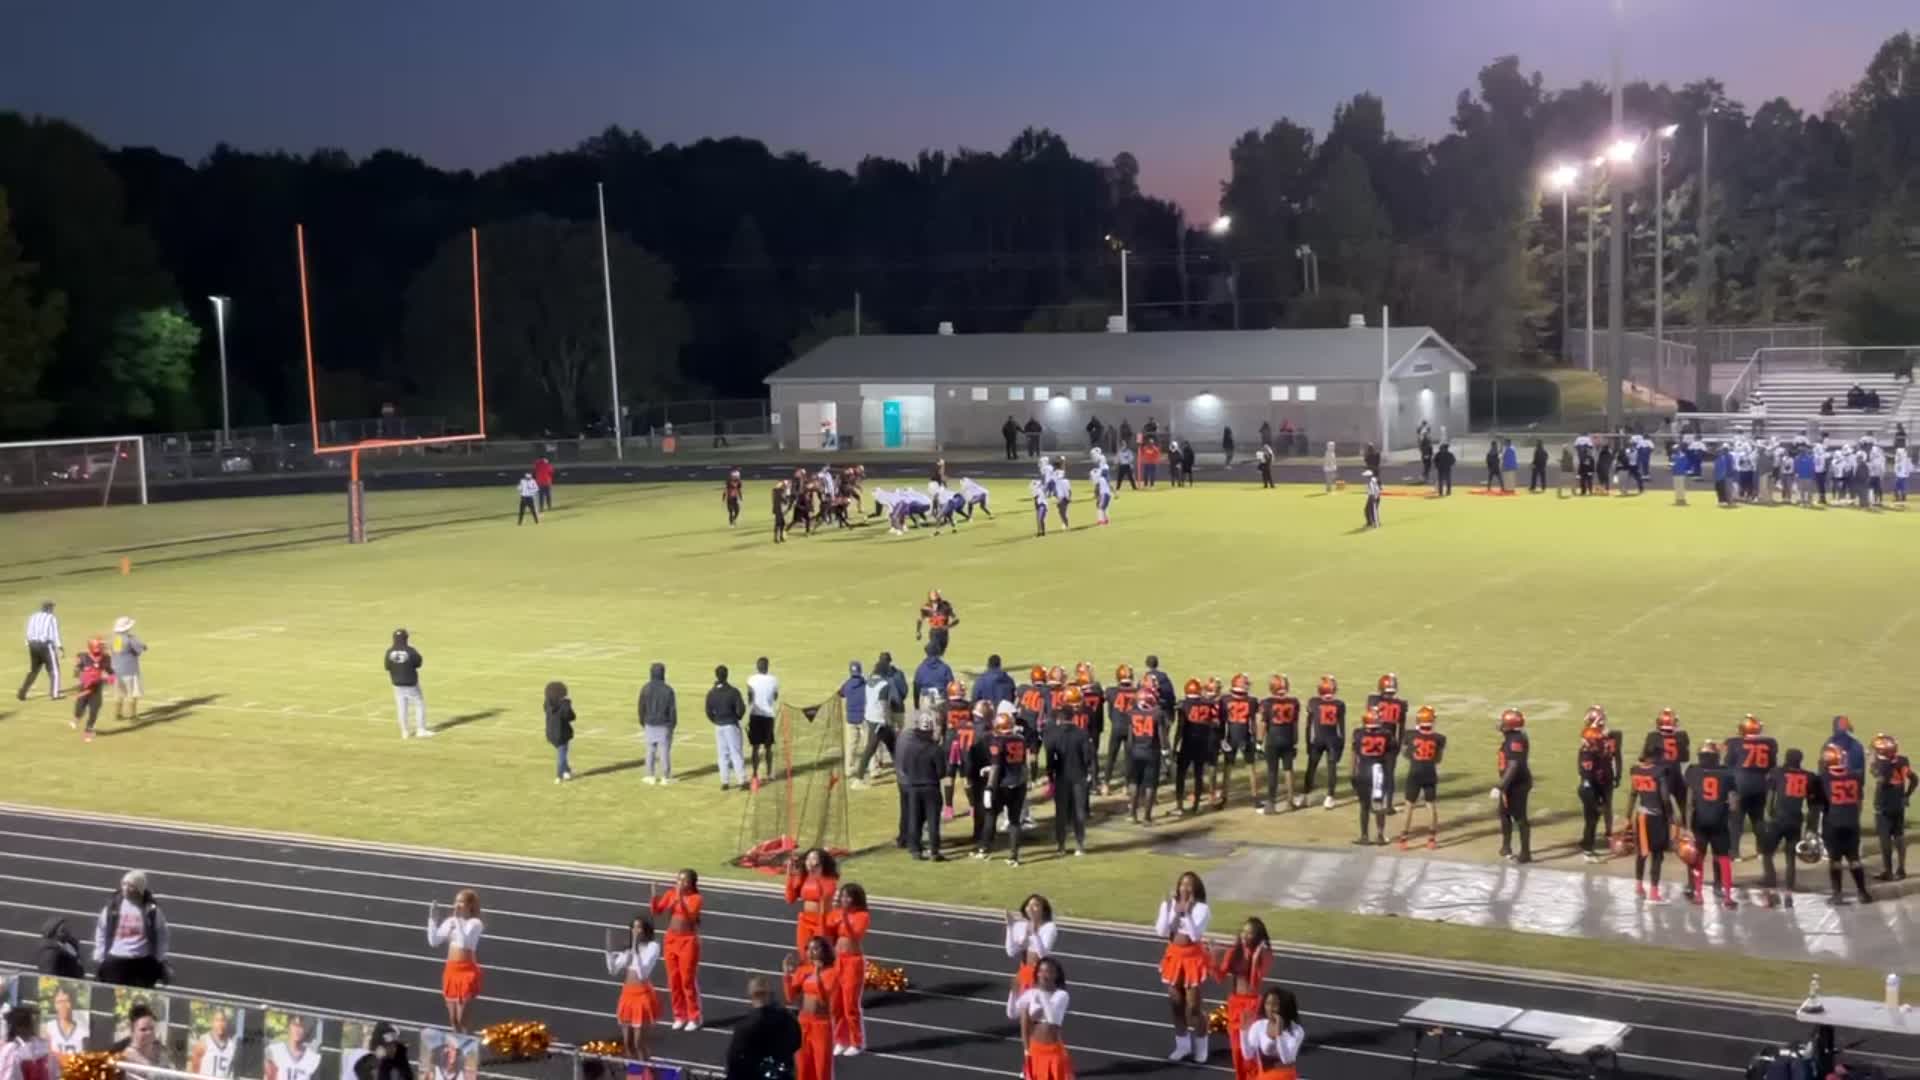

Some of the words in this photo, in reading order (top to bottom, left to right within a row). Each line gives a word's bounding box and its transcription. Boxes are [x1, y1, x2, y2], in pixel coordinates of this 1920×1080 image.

[1227, 702, 1249, 723] 32
[1320, 703, 1337, 725] 13
[1132, 714, 1154, 737] 54
[1361, 736, 1386, 756] 23
[1663, 738, 1678, 761] 5
[1742, 743, 1769, 768] 76
[1703, 776, 1719, 801] 9
[1830, 779, 1859, 805] 53
